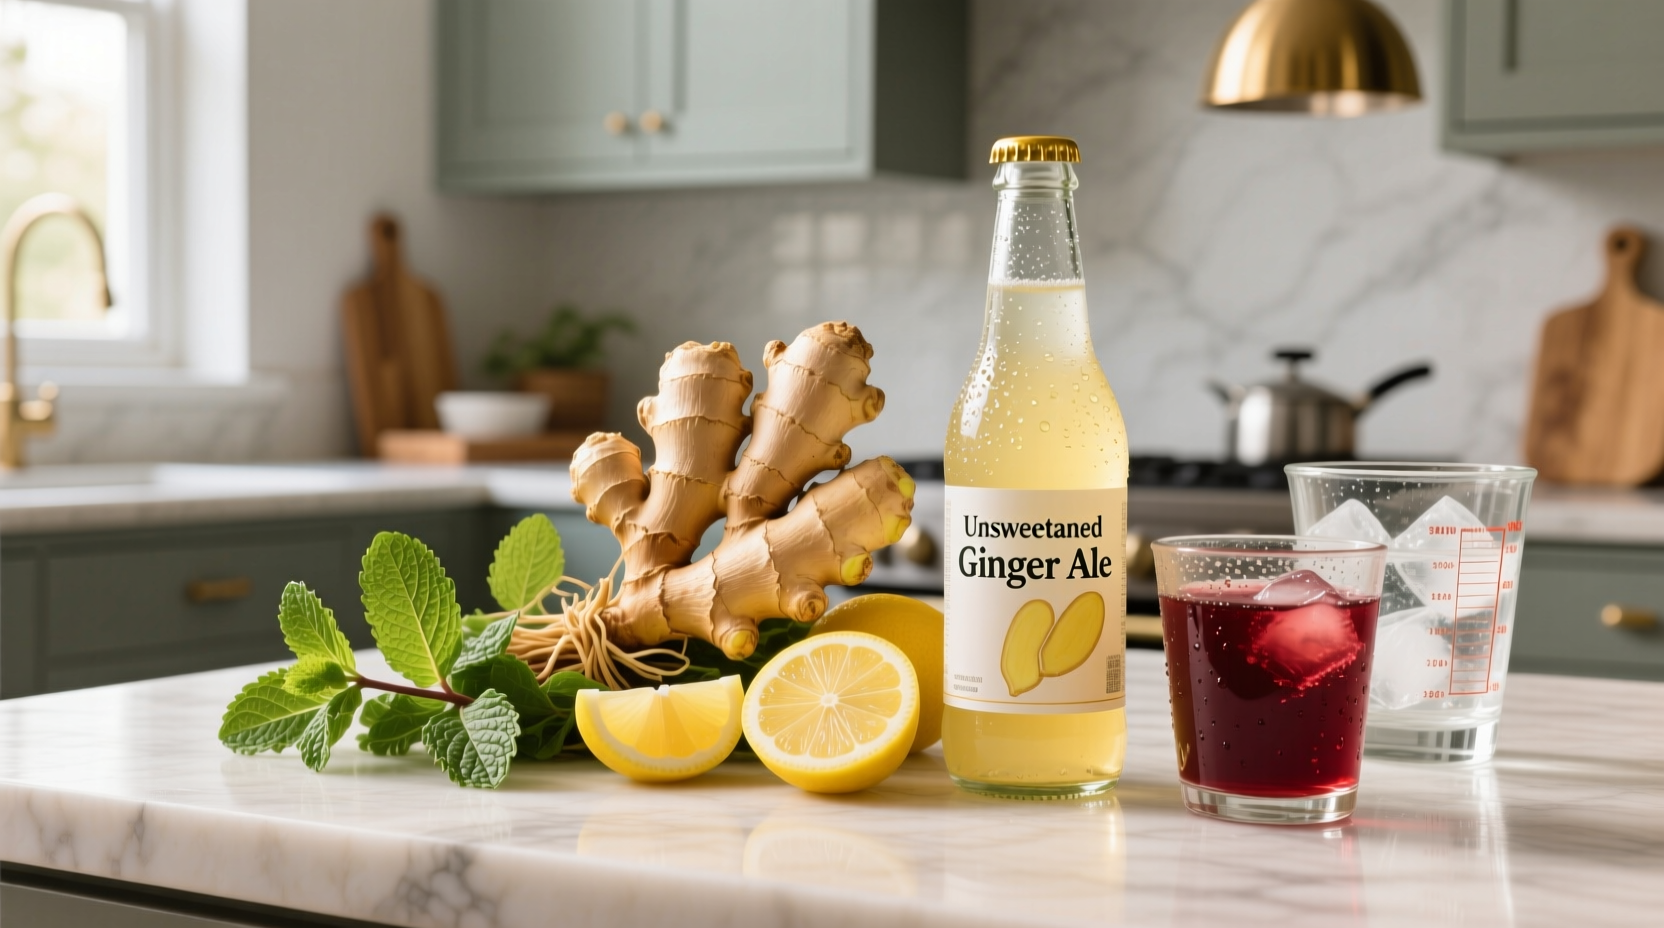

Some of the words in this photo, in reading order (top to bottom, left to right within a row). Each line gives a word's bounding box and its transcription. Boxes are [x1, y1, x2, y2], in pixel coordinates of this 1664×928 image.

[963, 514, 1103, 539] Unsweetaned
[958, 545, 1060, 590] Ginger
[1066, 546, 1112, 580] Ale
